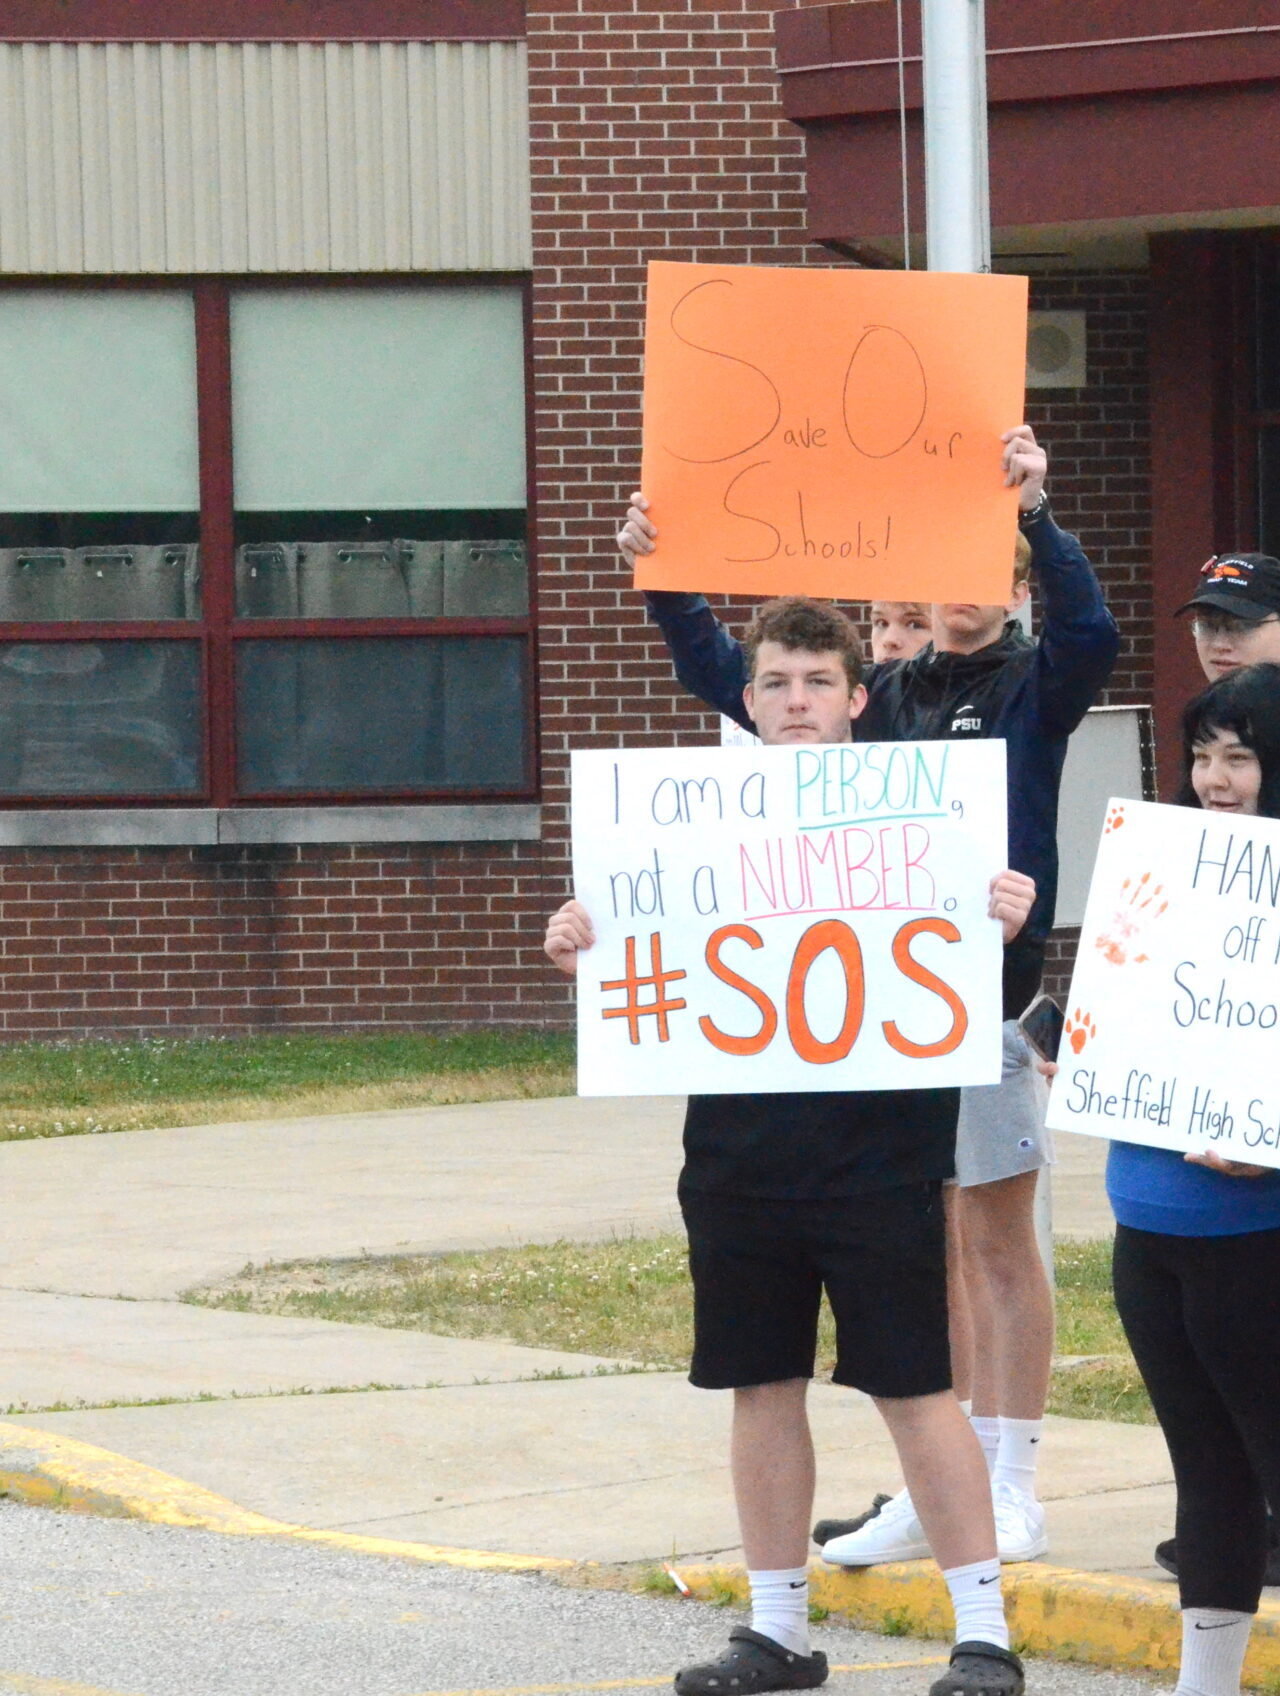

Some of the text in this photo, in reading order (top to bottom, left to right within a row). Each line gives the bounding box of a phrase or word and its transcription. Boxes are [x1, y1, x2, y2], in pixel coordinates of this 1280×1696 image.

[663, 279, 961, 463] Save Our
[724, 460, 891, 563] Schools!
[951, 718, 982, 731] PSU
[613, 763, 620, 825] I
[652, 776, 723, 825] am
[740, 772, 766, 818] a
[609, 848, 665, 918] not
[693, 865, 719, 915] a
[600, 917, 969, 1064] #SOS
[1067, 1069, 1176, 1127] Sheffield
[1189, 1085, 1234, 1141] High
